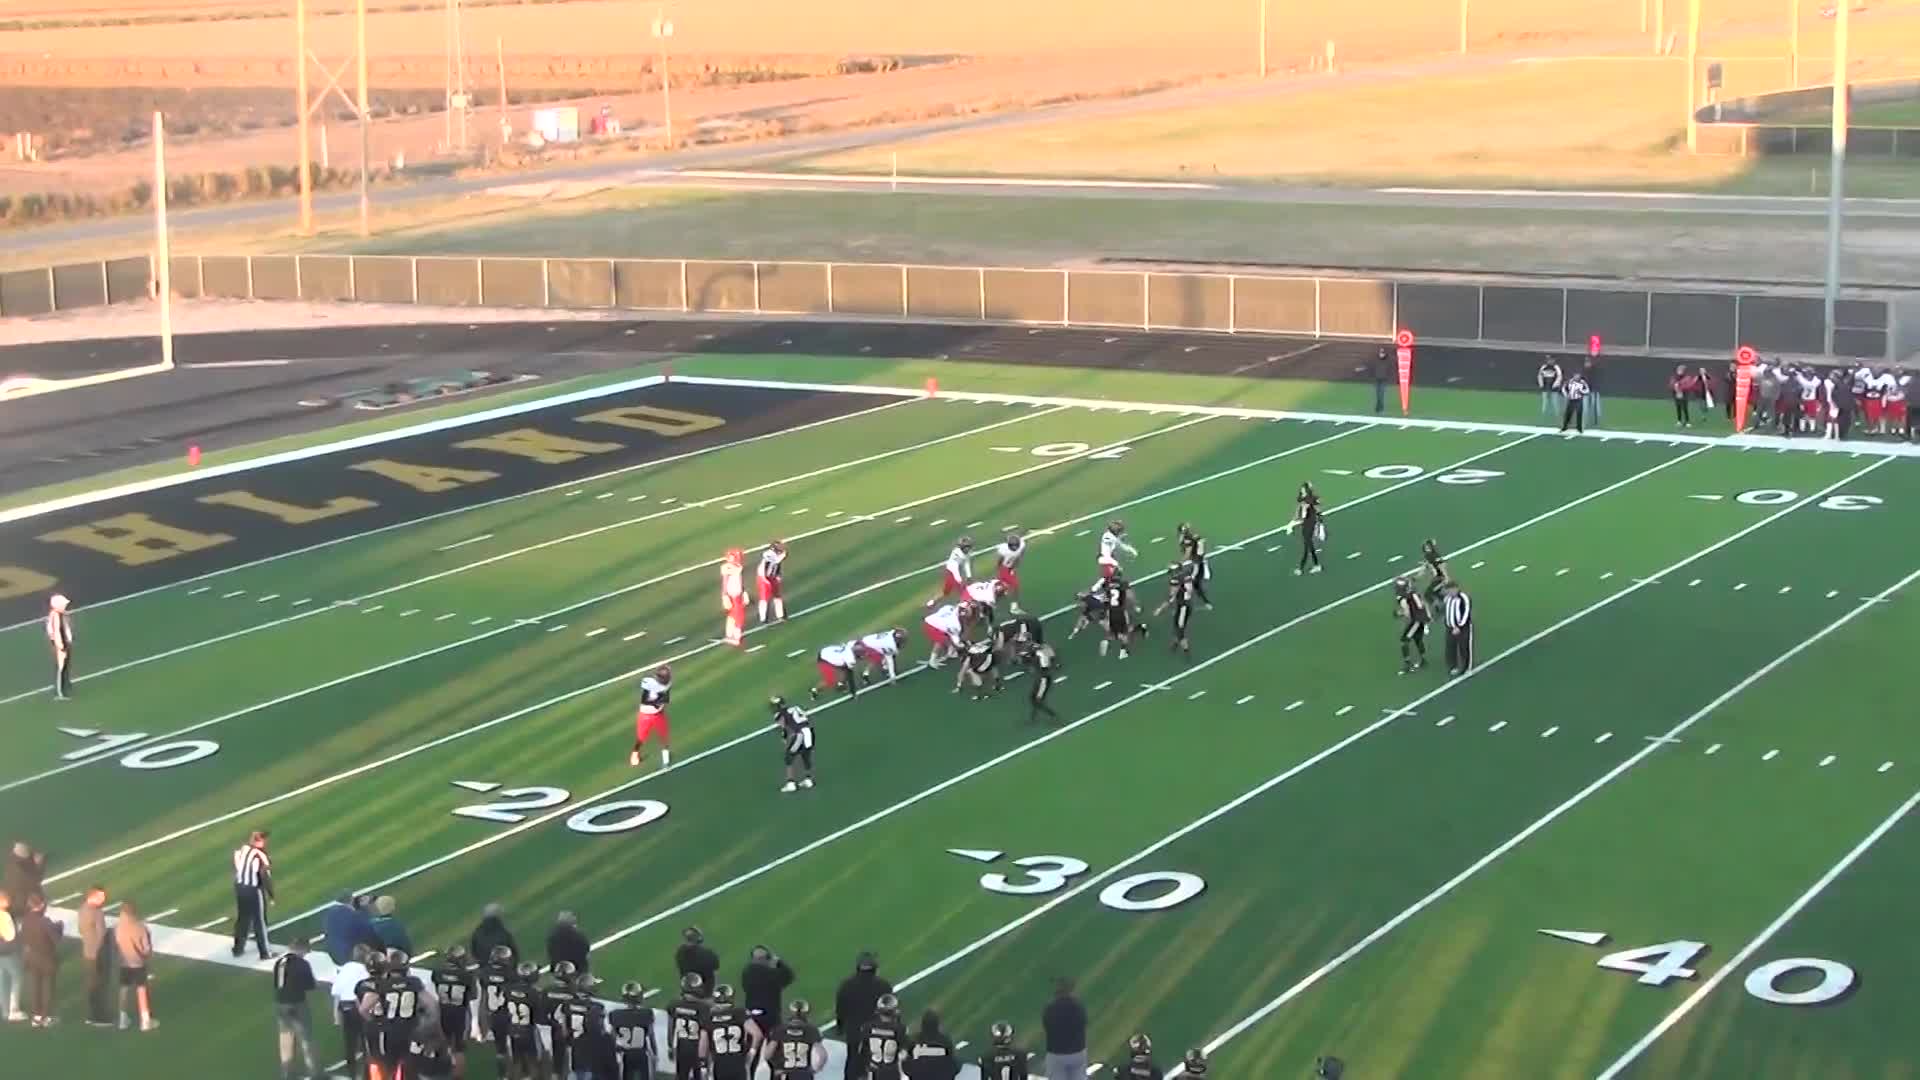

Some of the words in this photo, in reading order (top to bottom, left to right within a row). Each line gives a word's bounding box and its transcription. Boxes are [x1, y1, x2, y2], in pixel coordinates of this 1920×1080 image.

[0, 405, 727, 599] HLAND
[60, 732, 220, 769] 10
[451, 786, 669, 832] 20
[979, 855, 1205, 911] 30
[1596, 940, 1855, 1004] 40
[712, 1025, 742, 1054] 62
